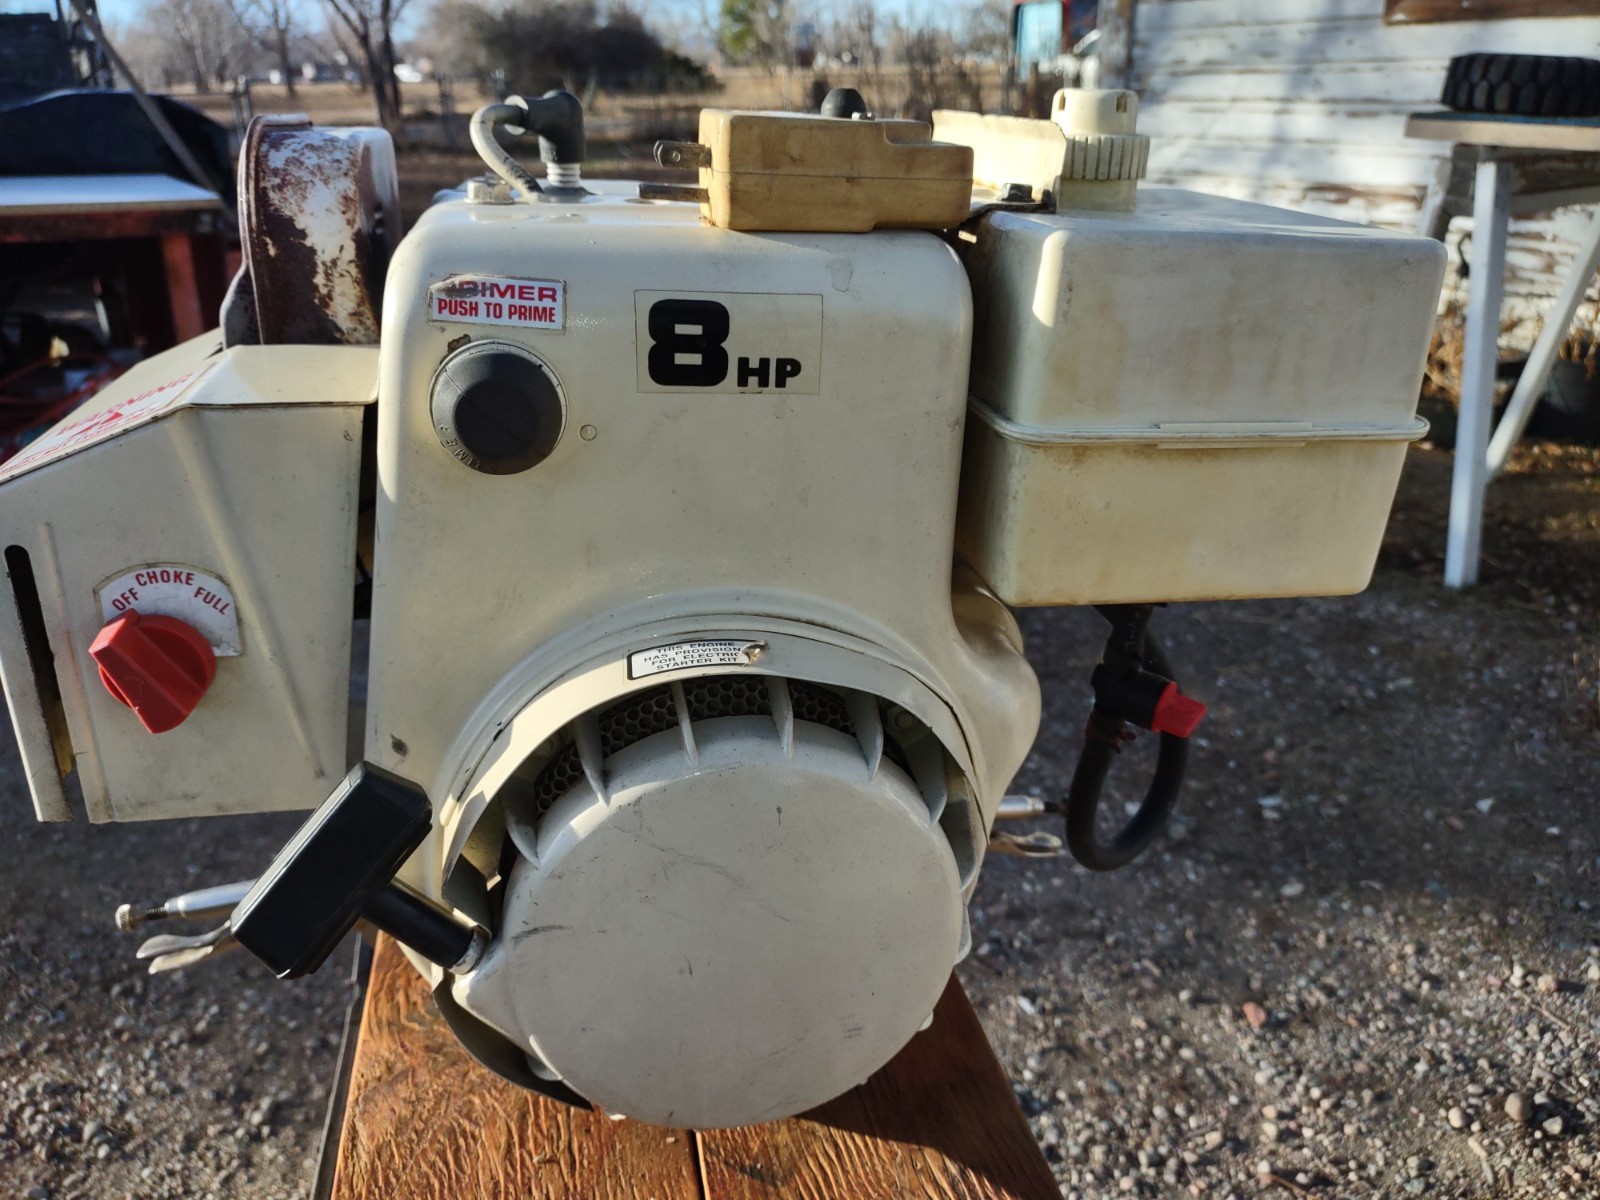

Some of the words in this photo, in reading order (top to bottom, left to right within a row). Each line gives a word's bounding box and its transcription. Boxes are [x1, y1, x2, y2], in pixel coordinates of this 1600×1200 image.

[445, 280, 558, 303] RIMER
[438, 298, 478, 317] PUSH
[485, 302, 503, 319] TO
[508, 305, 556, 323] PRIME
[648, 298, 730, 387] 8
[737, 357, 802, 388] HP
[135, 569, 195, 587] CHOKE
[112, 587, 139, 612] OFF
[193, 586, 231, 615] FULL
[644, 653, 668, 662] HAS
[675, 647, 741, 656] PROVISION
[656, 645, 683, 653] THIS
[652, 657, 676, 666] FOR
[656, 658, 712, 670] STARTER
